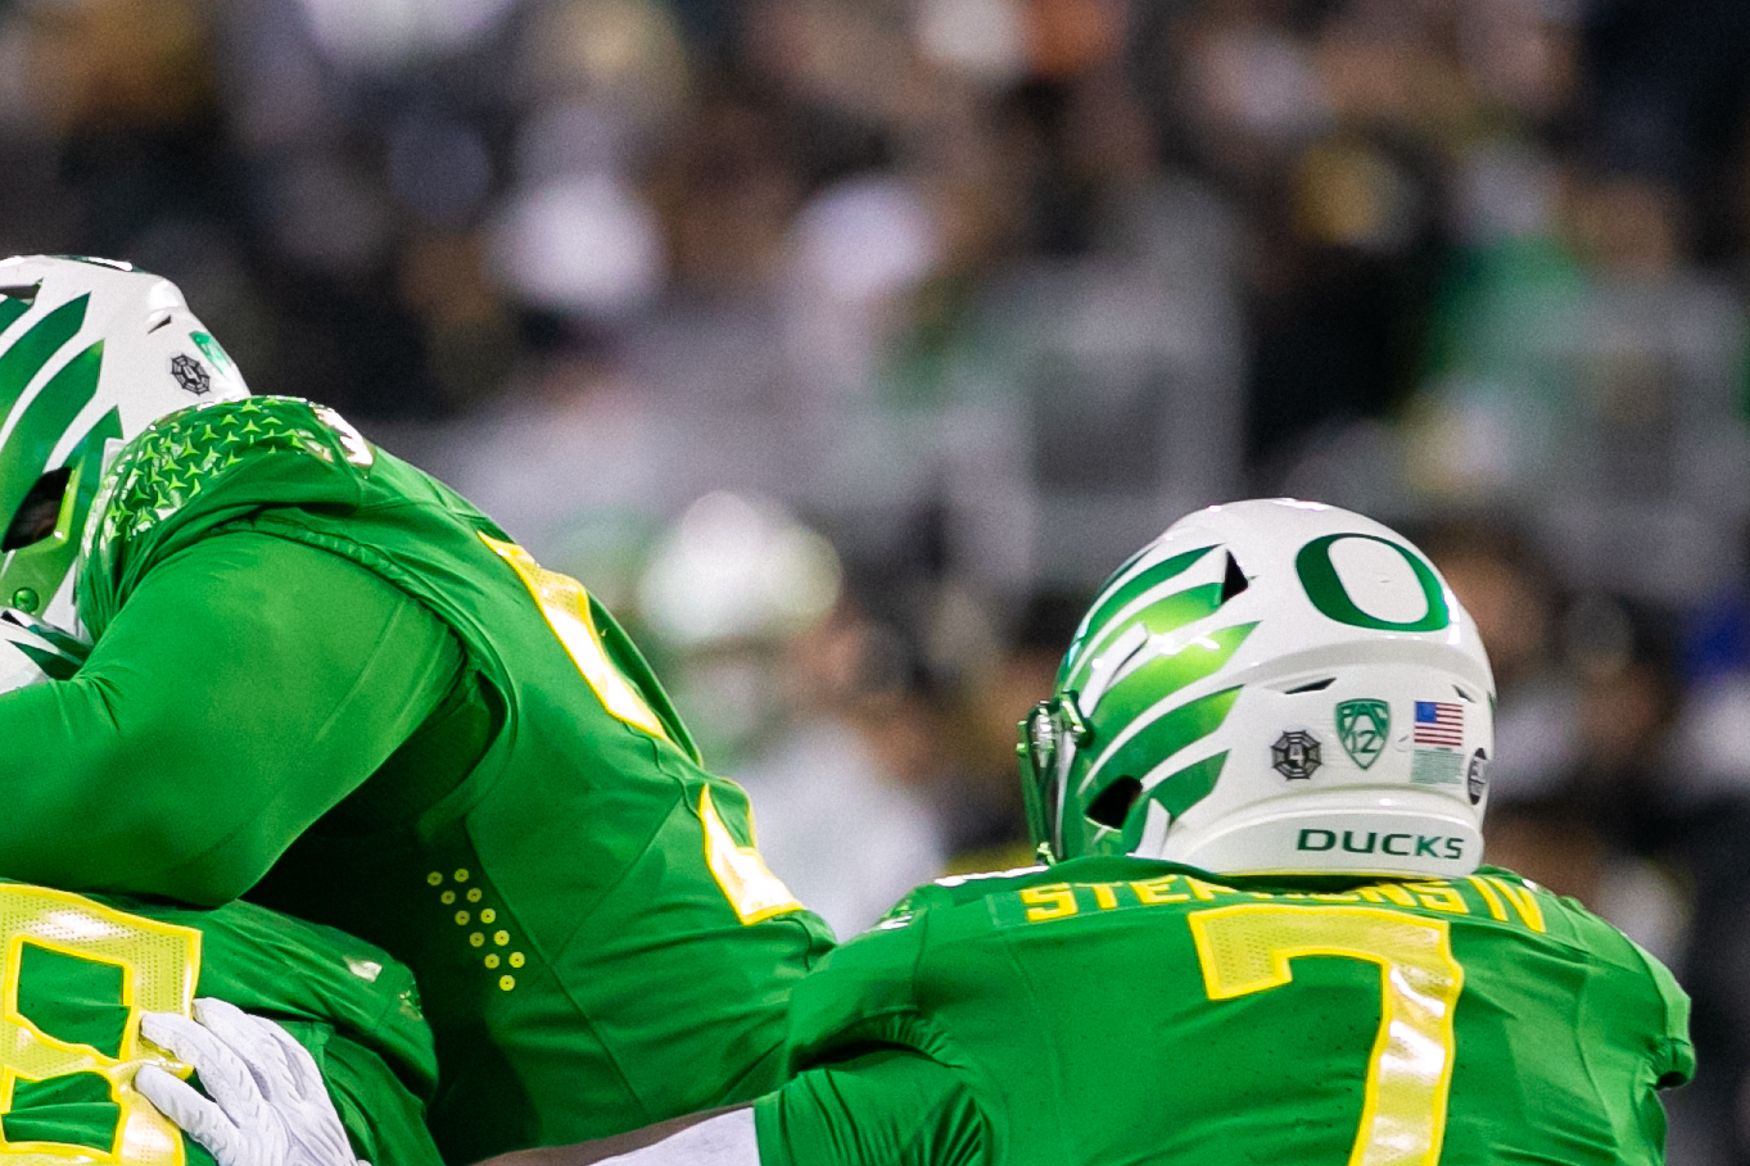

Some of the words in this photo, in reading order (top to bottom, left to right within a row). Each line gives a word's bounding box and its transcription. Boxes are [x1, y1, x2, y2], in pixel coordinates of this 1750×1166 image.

[1295, 532, 1450, 632] O
[1350, 730, 1378, 753] 12
[1297, 828, 1464, 860] DUCKS
